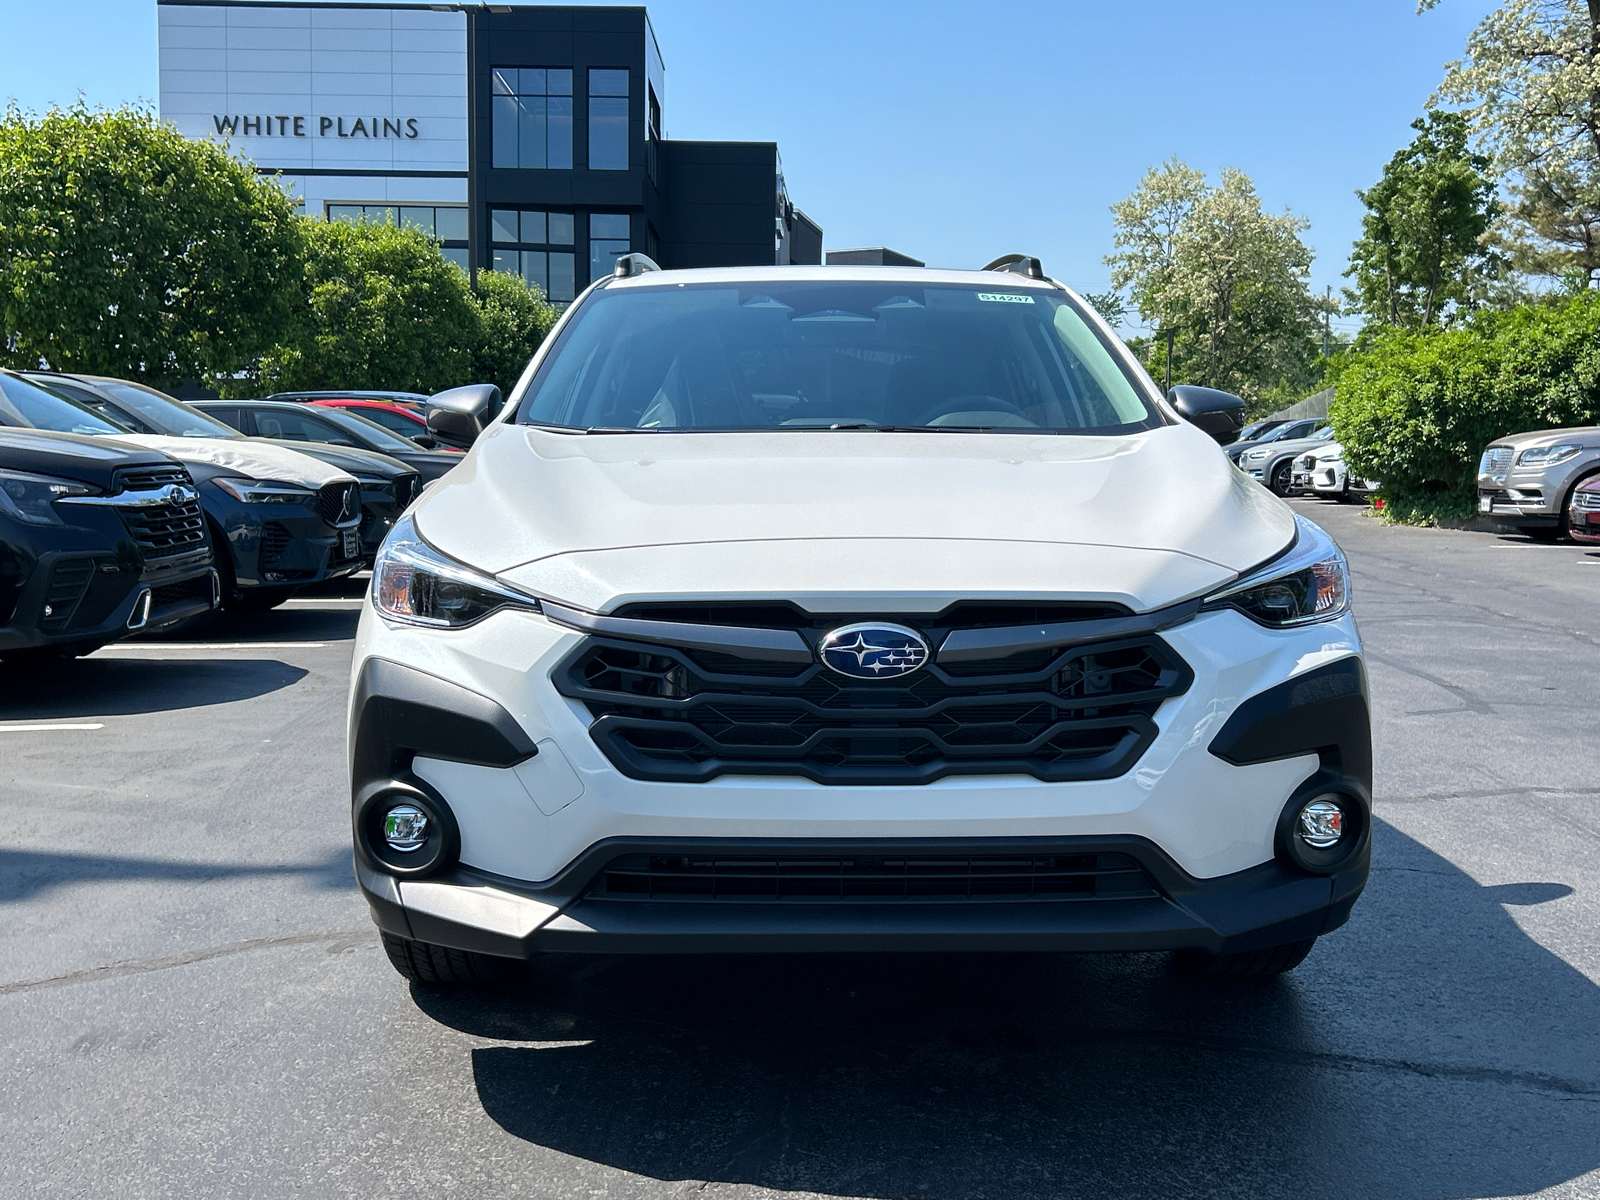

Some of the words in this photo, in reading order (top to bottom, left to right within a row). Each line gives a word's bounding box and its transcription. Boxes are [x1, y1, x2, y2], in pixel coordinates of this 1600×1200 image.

[213, 115, 305, 136] WHITE
[319, 116, 419, 139] PLAINS
[980, 294, 1029, 302] S14297
